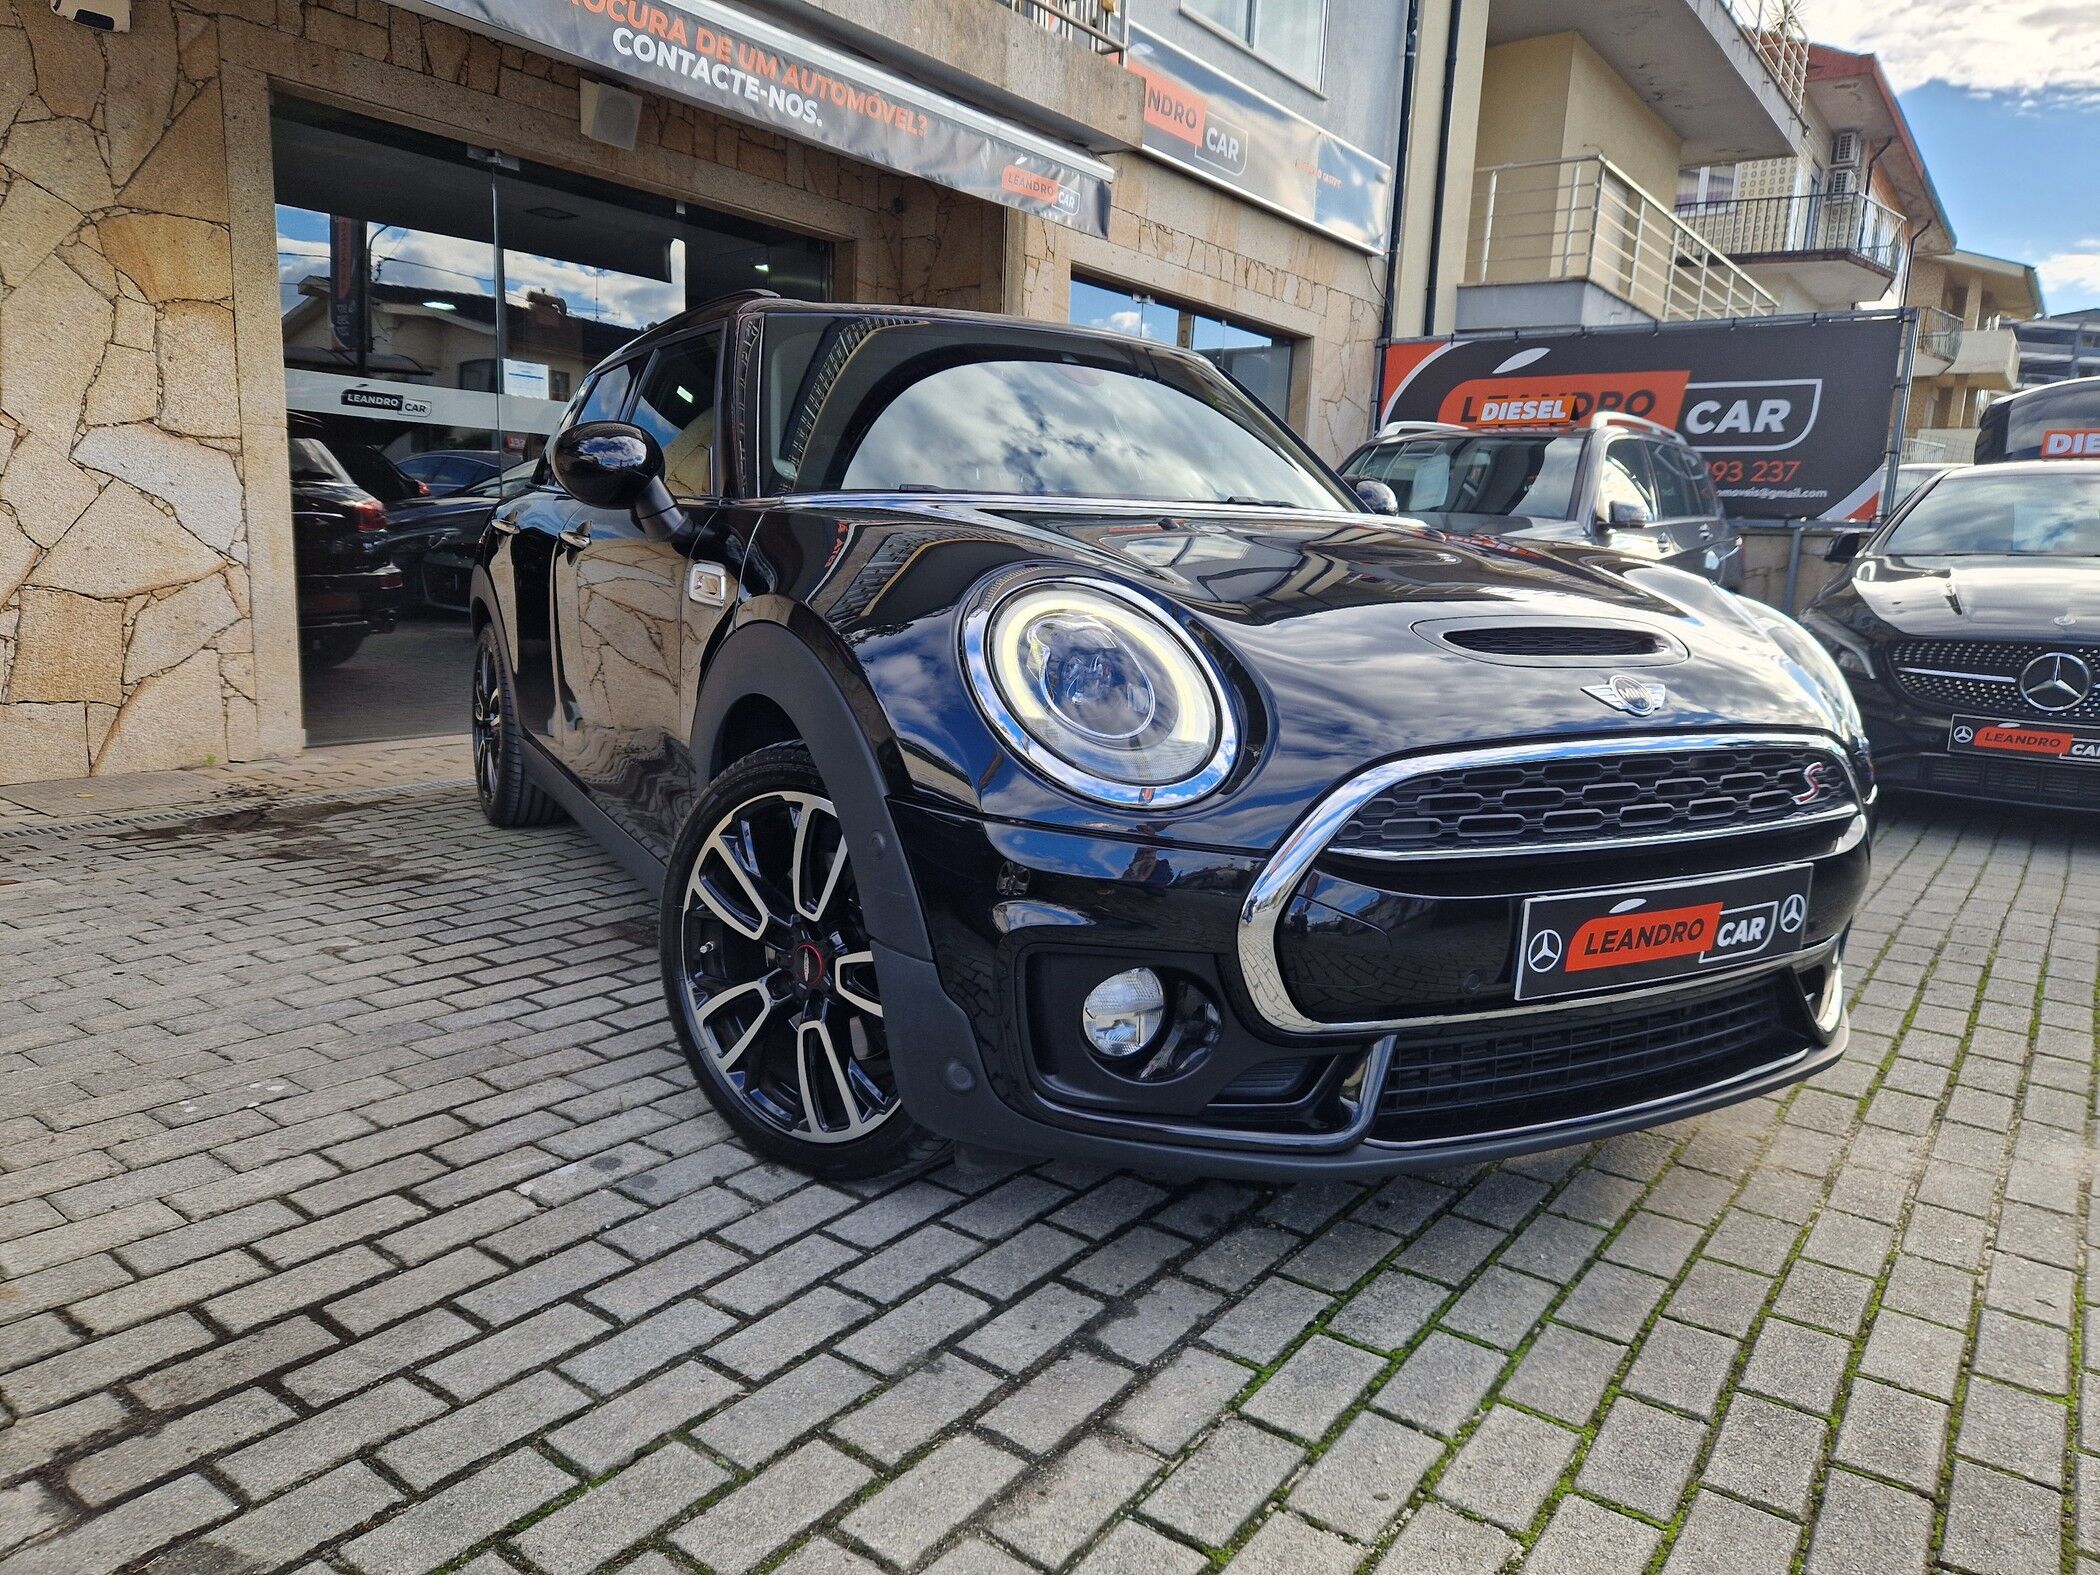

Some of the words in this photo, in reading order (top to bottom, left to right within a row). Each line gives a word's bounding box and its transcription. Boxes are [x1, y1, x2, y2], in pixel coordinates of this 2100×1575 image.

[570, 0, 688, 47] OCURA
[696, 26, 733, 64] DE
[739, 43, 777, 80] UM
[782, 63, 928, 138] AUTOMÓVEL?
[612, 27, 823, 127] CONTACTE-NOS.
[1206, 126, 1239, 162] CAR
[1008, 172, 1054, 195] LEANDRO
[1058, 191, 1075, 209] CAR
[347, 393, 399, 407] LEANDRO
[404, 403, 427, 413] CAR
[1460, 389, 1656, 422] LDRO
[1686, 400, 1790, 434] CAR
[1481, 400, 1566, 422] DIESEL
[1706, 461, 1743, 482] 93
[1750, 461, 1801, 482] 237
[1984, 732, 2061, 748] LEANDRO
[1584, 918, 1705, 956] LEANDRO
[1717, 916, 1768, 948] CAR
